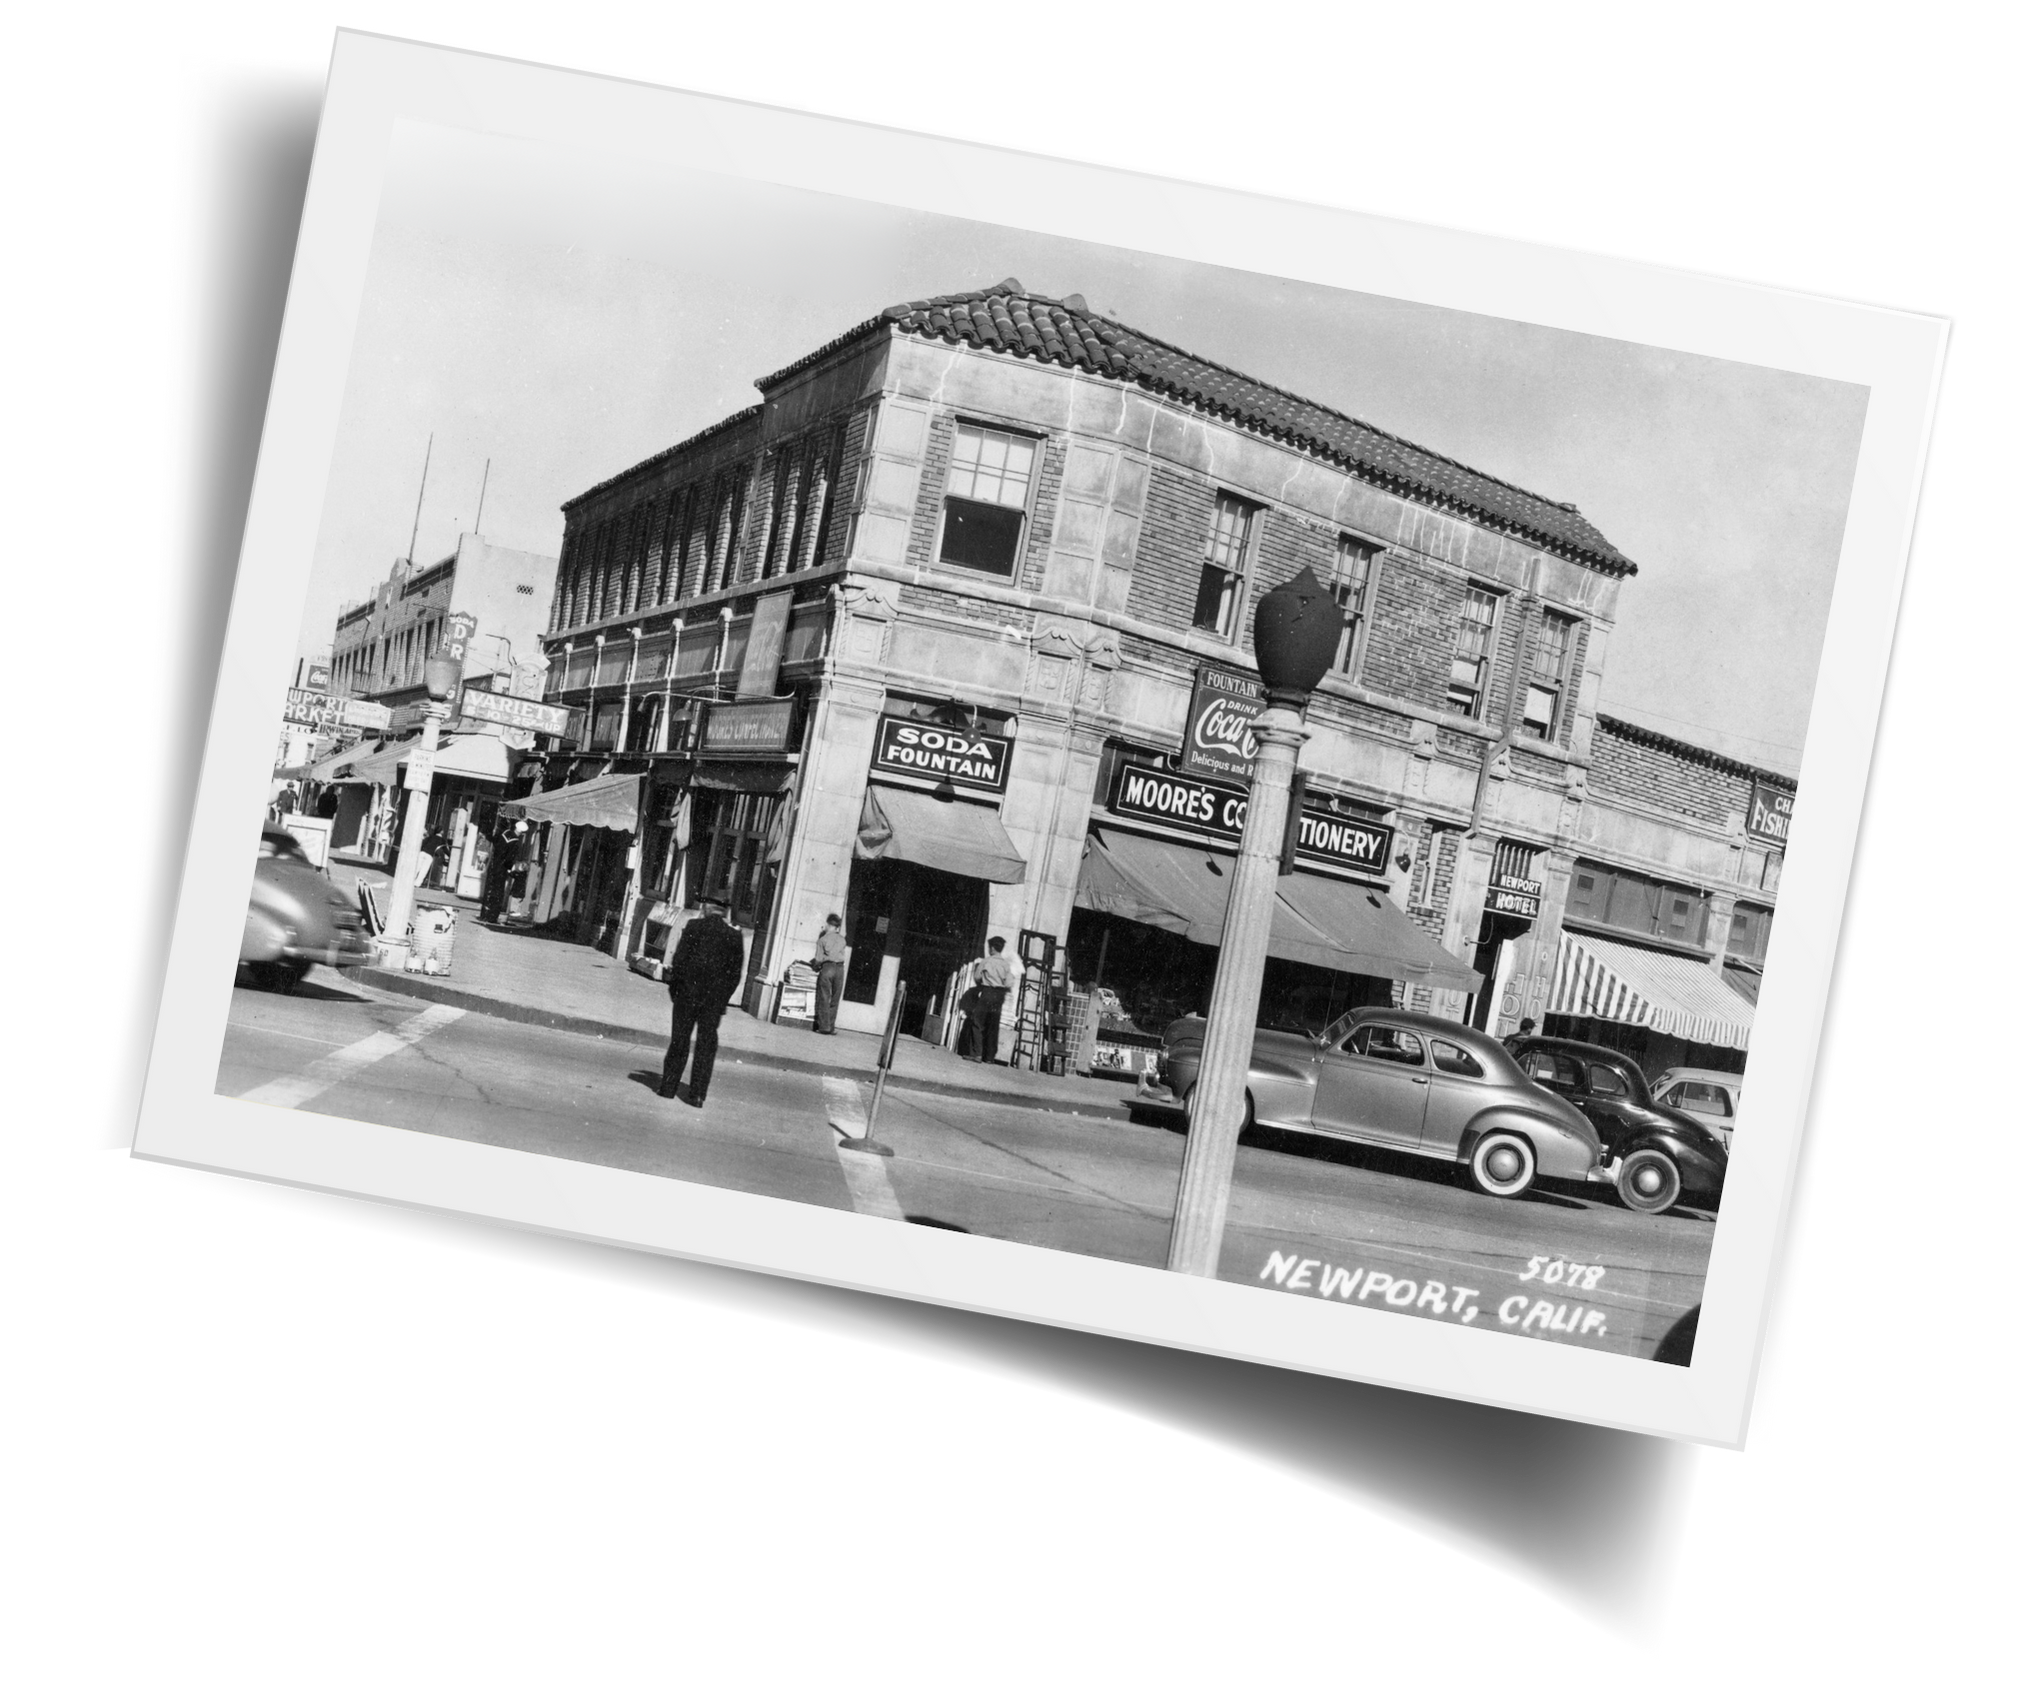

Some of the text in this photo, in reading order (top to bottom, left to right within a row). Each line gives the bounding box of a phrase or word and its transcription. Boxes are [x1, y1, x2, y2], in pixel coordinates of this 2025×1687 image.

[1207, 672, 1258, 697] FOUNTAIN
[468, 690, 563, 724] VARIETY
[1227, 701, 1259, 715] DRINK
[896, 728, 993, 760] SODA
[887, 745, 996, 780] FOUNTAIN
[1191, 751, 1230, 771] Delicious
[1231, 764, 1246, 776] and
[1126, 776, 1215, 821] MOORE'S
[1774, 797, 1793, 814] CH
[1750, 797, 1789, 840] FISHI
[1500, 874, 1541, 894] NEWPORT
[1496, 892, 1537, 915] HOTEL
